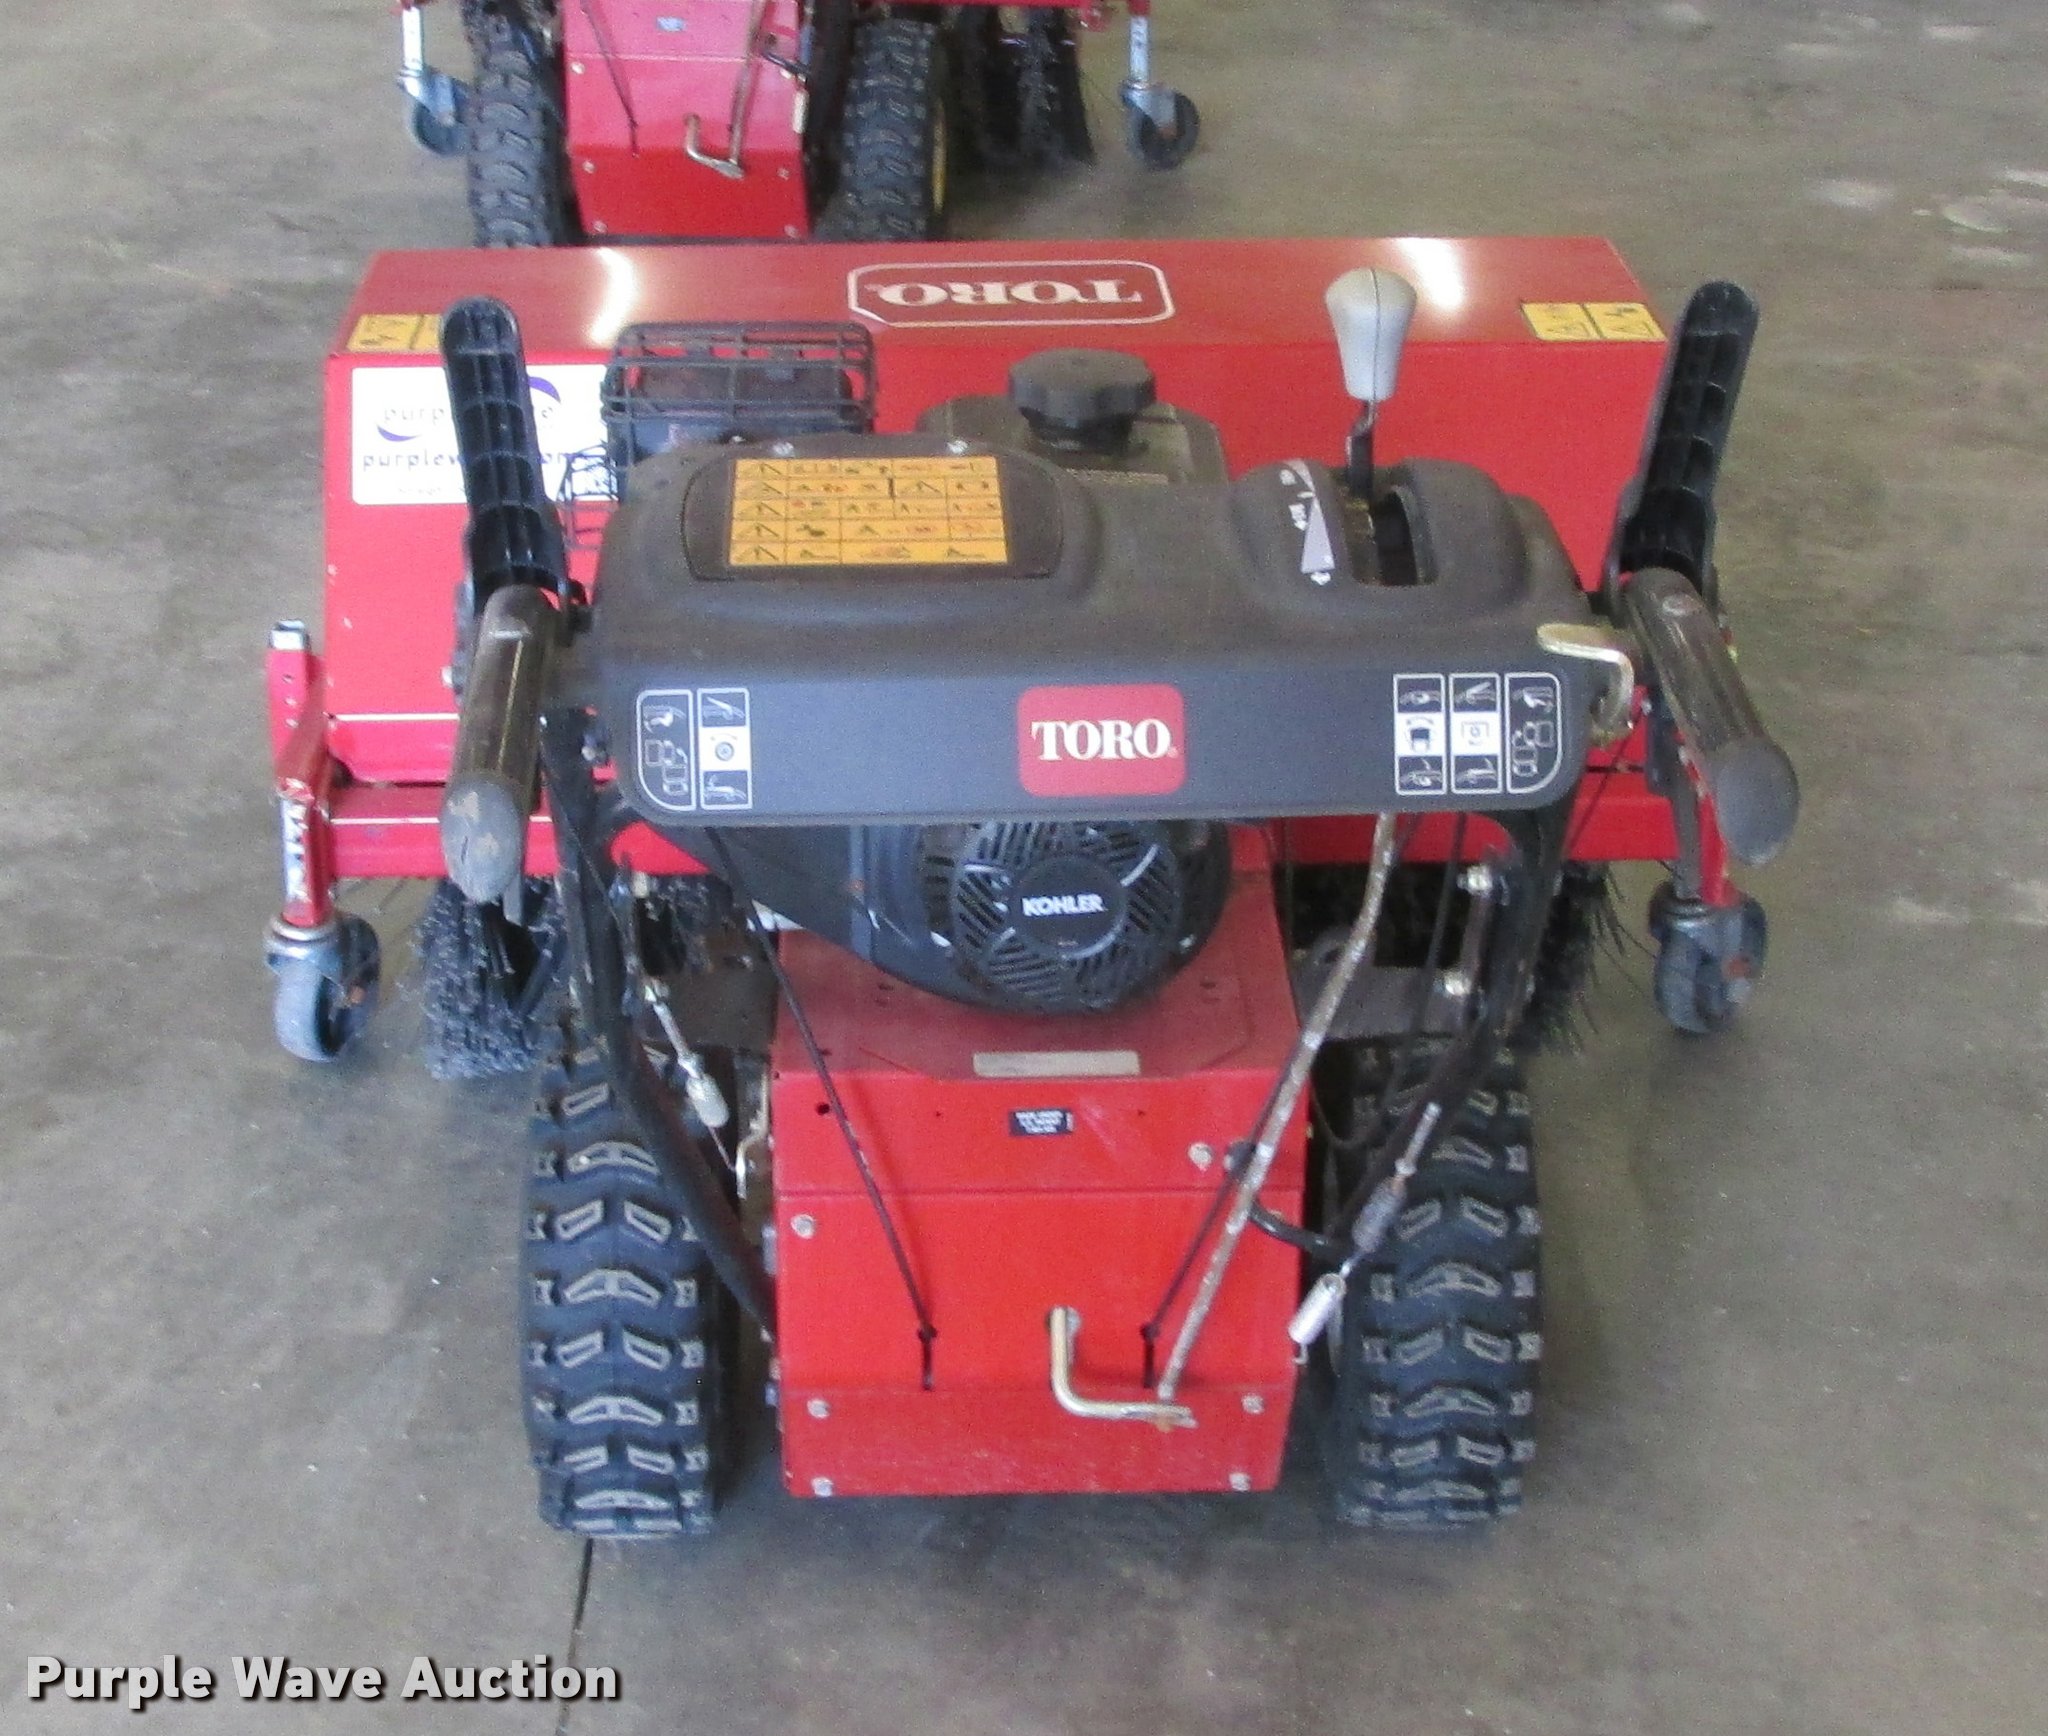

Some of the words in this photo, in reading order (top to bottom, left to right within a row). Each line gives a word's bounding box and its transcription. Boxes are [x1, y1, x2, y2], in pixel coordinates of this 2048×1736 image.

[875, 278, 1143, 306] TORO
[384, 407, 446, 426] purp
[1031, 718, 1173, 761] TORO
[1022, 893, 1105, 916] KOHLER
